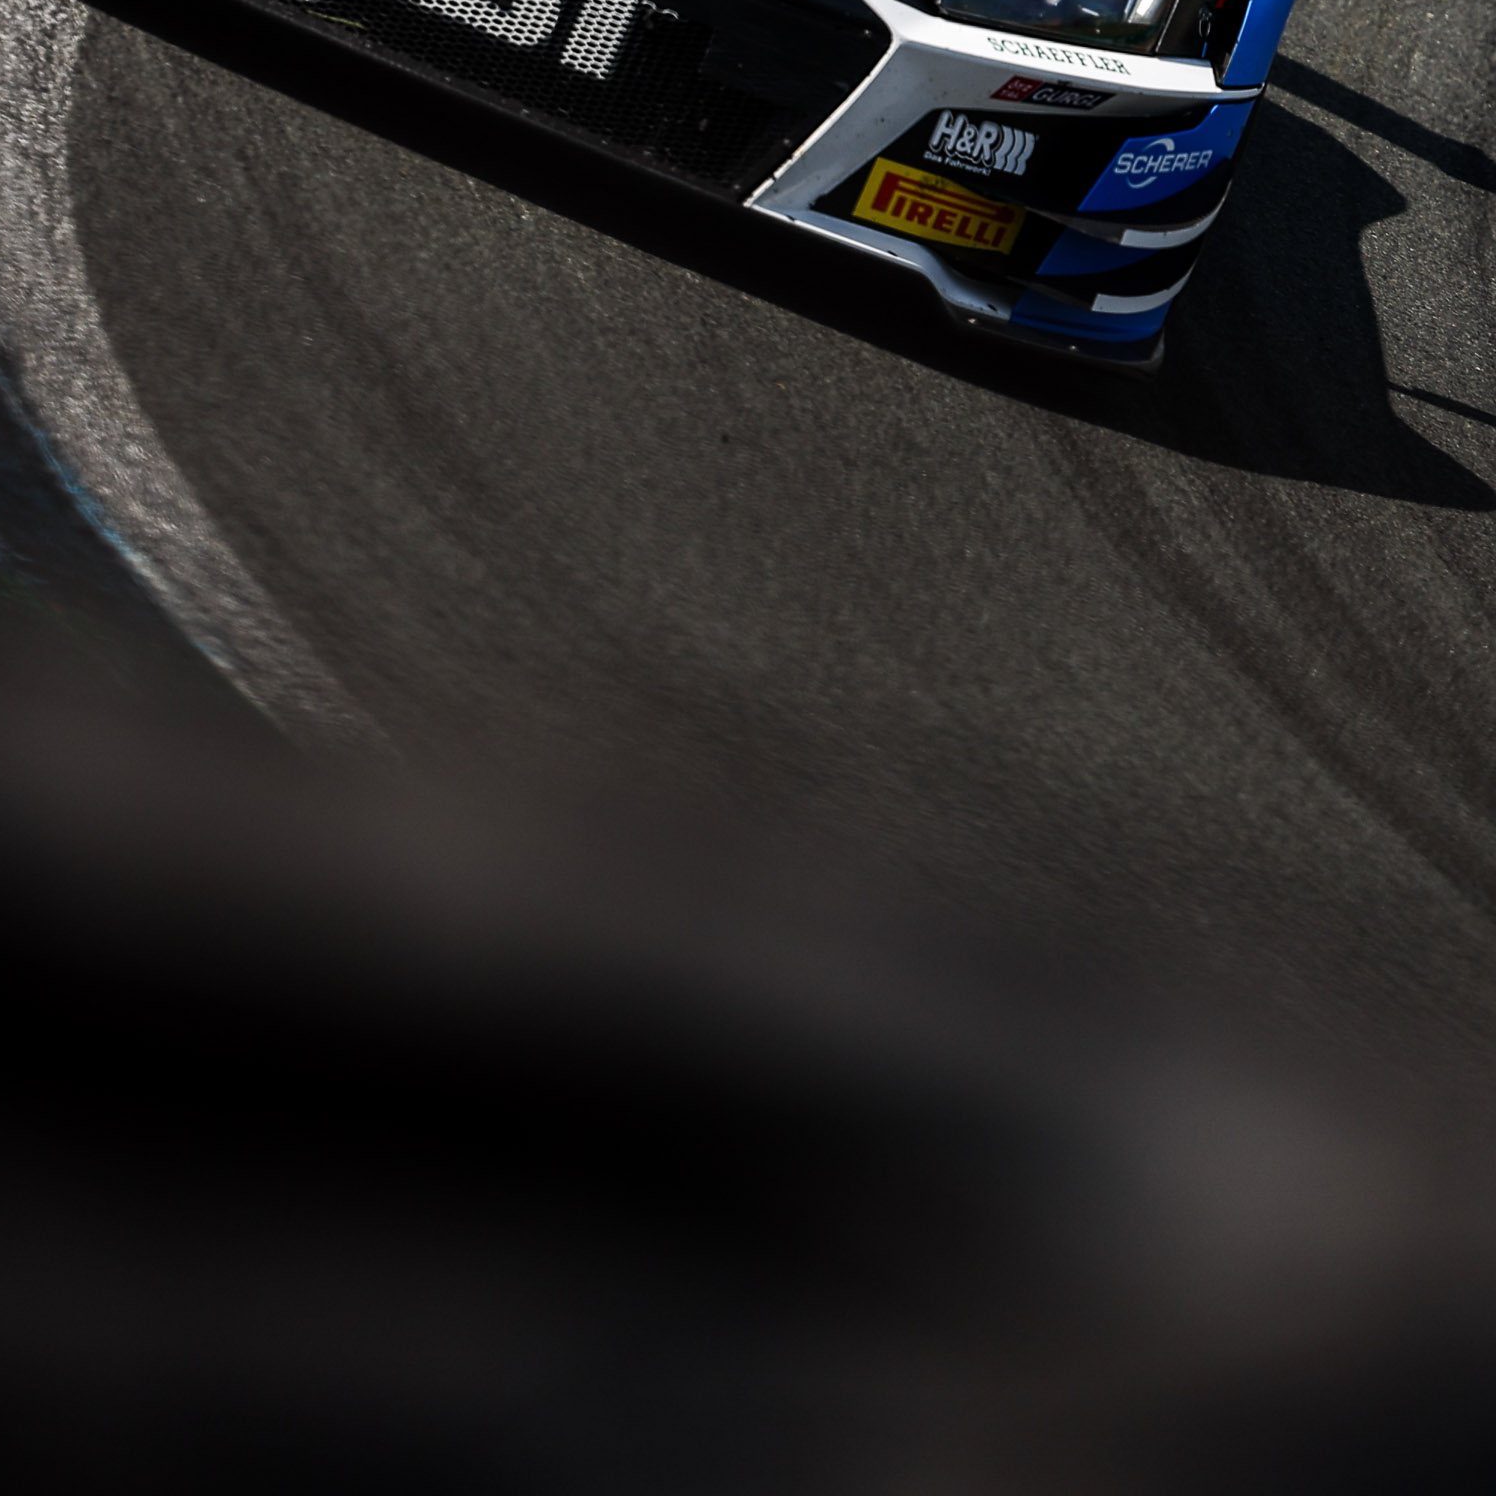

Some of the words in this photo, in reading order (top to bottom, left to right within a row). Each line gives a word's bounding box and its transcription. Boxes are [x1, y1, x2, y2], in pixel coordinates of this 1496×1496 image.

[987, 36, 1132, 76] SCHAEFFLER
[929, 109, 1004, 168] H&R
[1114, 149, 1214, 175] SCHERER
[870, 171, 1016, 254] PIRELLI
